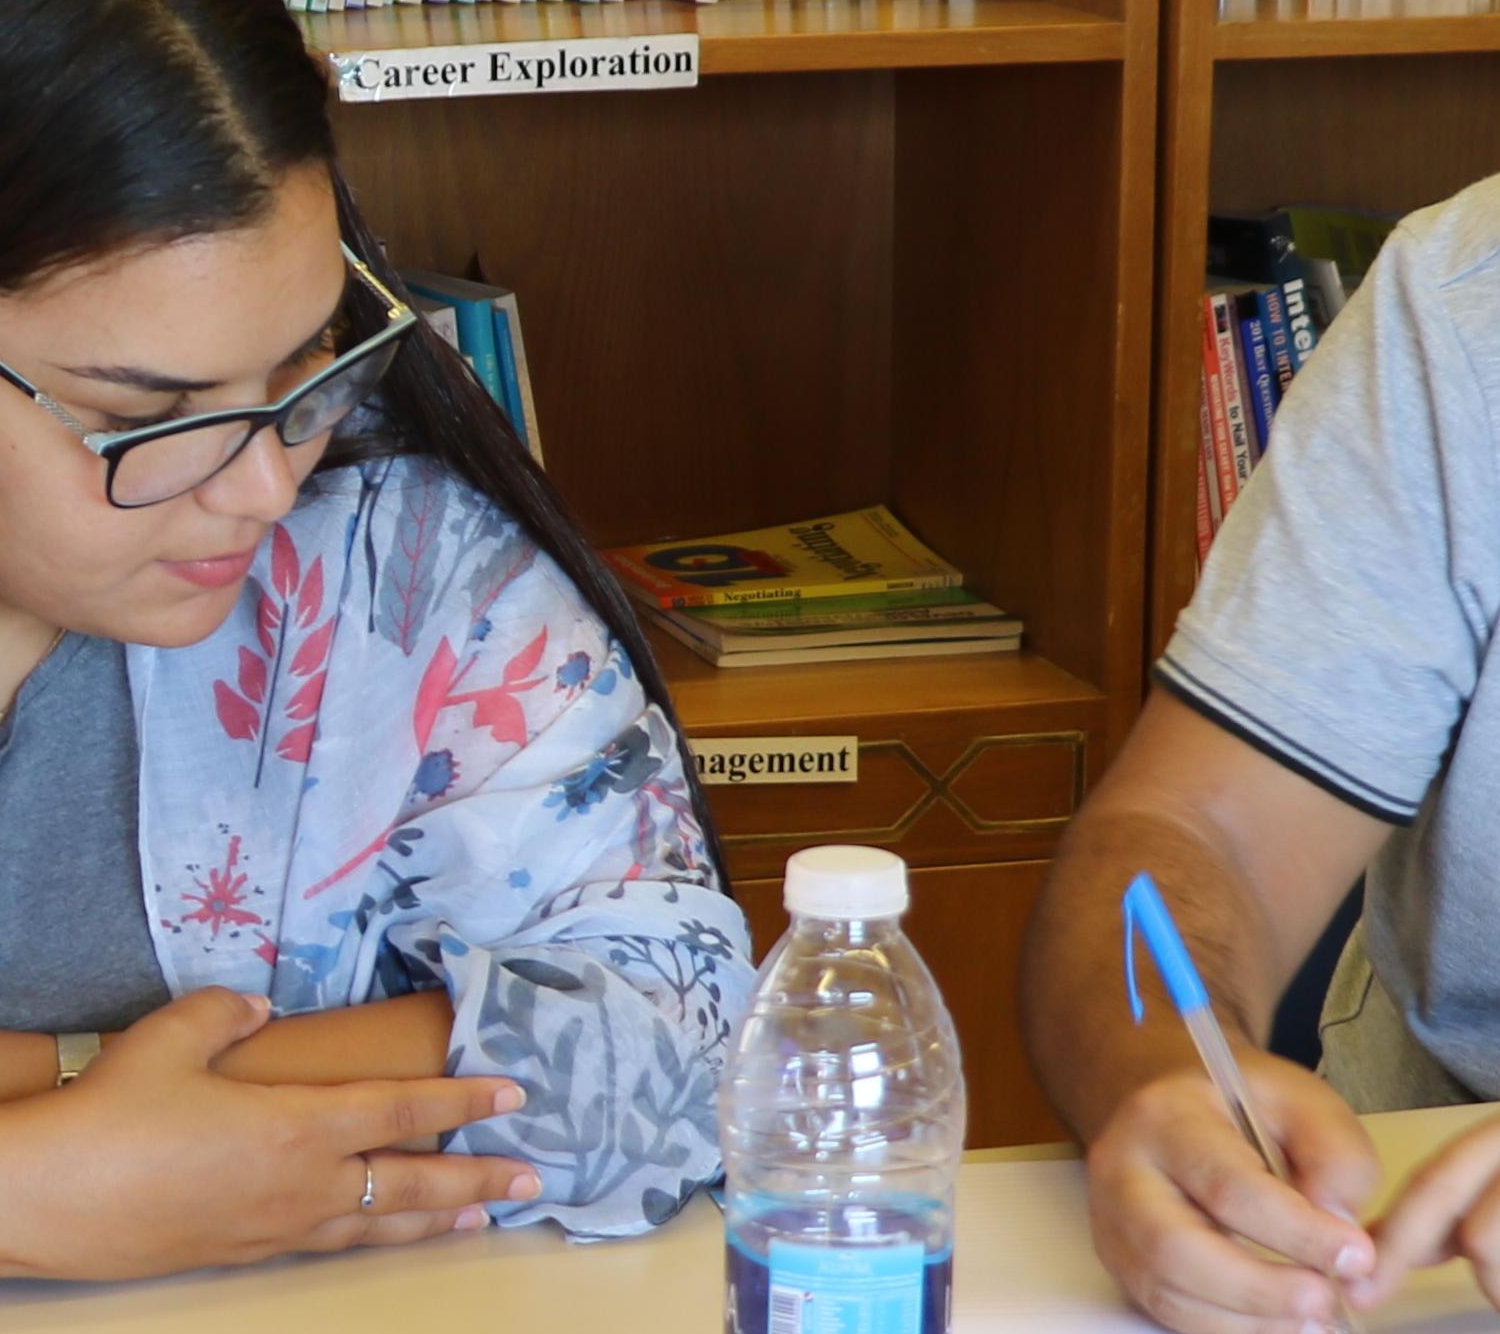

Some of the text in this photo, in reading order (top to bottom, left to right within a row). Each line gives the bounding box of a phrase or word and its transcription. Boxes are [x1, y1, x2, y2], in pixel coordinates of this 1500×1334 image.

[354, 46, 693, 89] Career Exploration
[723, 587, 803, 602] Negotiating
